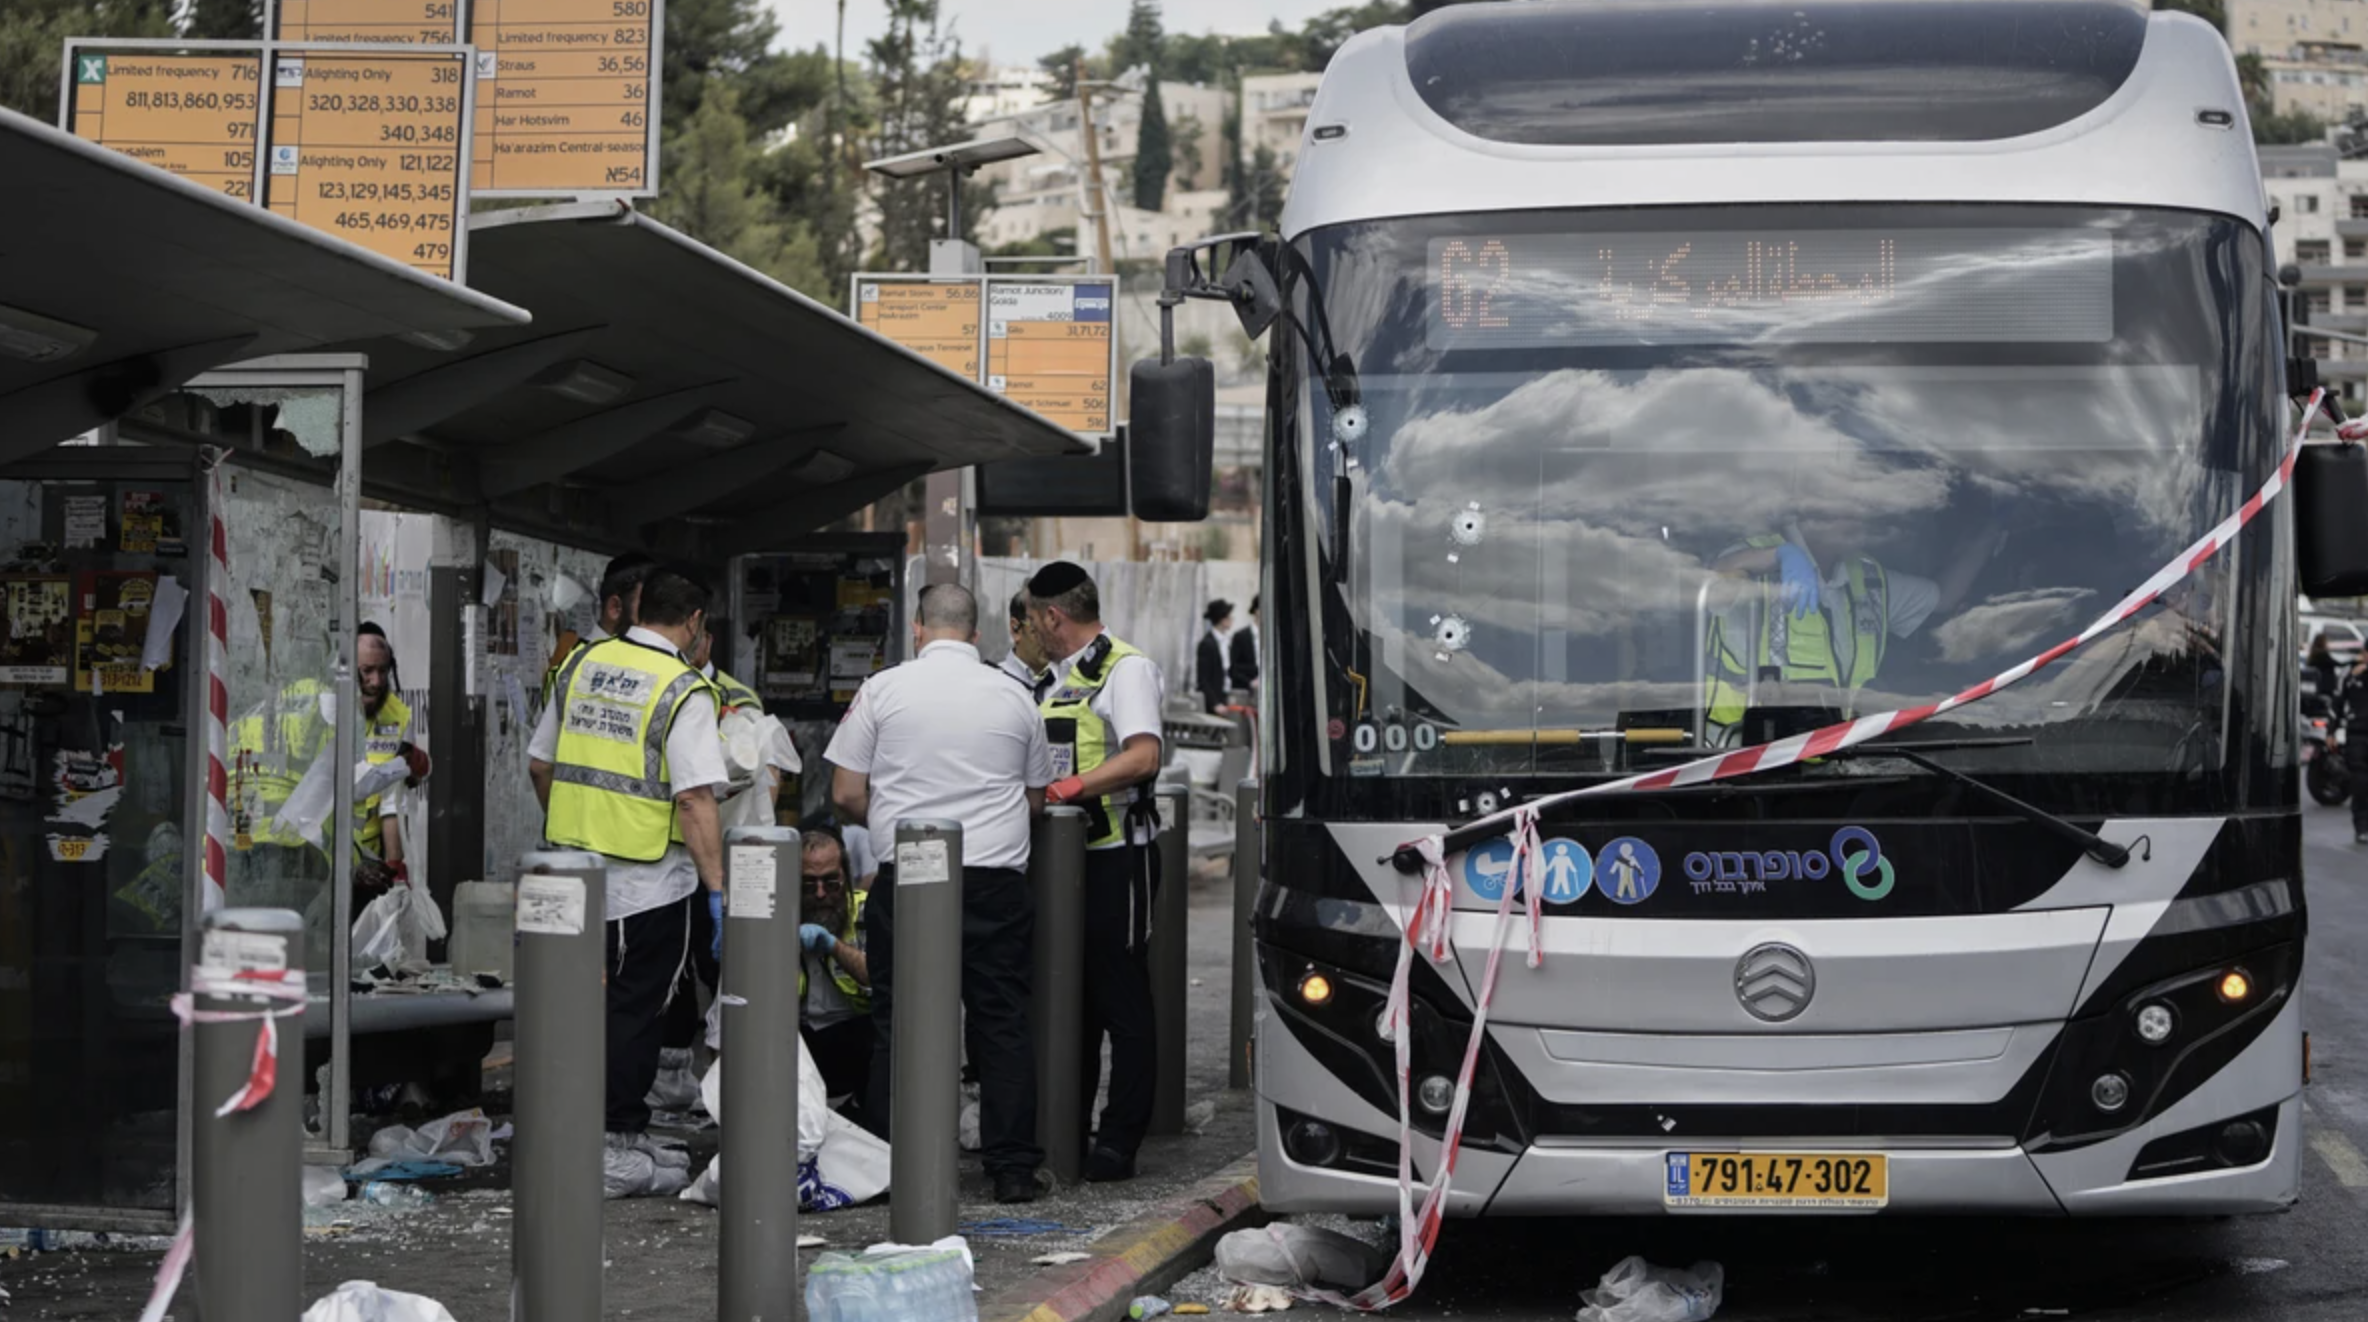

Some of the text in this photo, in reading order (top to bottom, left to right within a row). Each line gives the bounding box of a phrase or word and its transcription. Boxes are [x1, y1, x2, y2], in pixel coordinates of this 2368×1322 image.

[425, 4, 453, 18] 541
[613, 1, 648, 17] 580
[304, 33, 350, 43] Limited
[419, 31, 451, 43] 756
[499, 29, 646, 45] Limited frequency 823
[107, 64, 259, 80] Limited frequency 716
[498, 56, 645, 74] Straus 36,56
[305, 67, 459, 83] Alighting Only 318
[496, 83, 644, 99] Ramot 36
[125, 91, 256, 111] 811,813,860,953
[309, 94, 457, 114] 320,328,330,338
[495, 115, 516, 126] Har
[620, 111, 643, 127] 46
[227, 122, 255, 139] 971
[380, 125, 455, 144] 340,348
[224, 151, 253, 168] 105
[301, 155, 354, 169] Alighting
[357, 156, 387, 170] Only
[400, 155, 454, 174] 121,122
[224, 180, 251, 196] 221
[319, 182, 452, 202] 123,129,145,345
[335, 212, 450, 233] 465,469,475
[413, 243, 449, 259] 479
[1441, 239, 1509, 328] 62
[1684, 850, 1830, 881] סופרבוס
